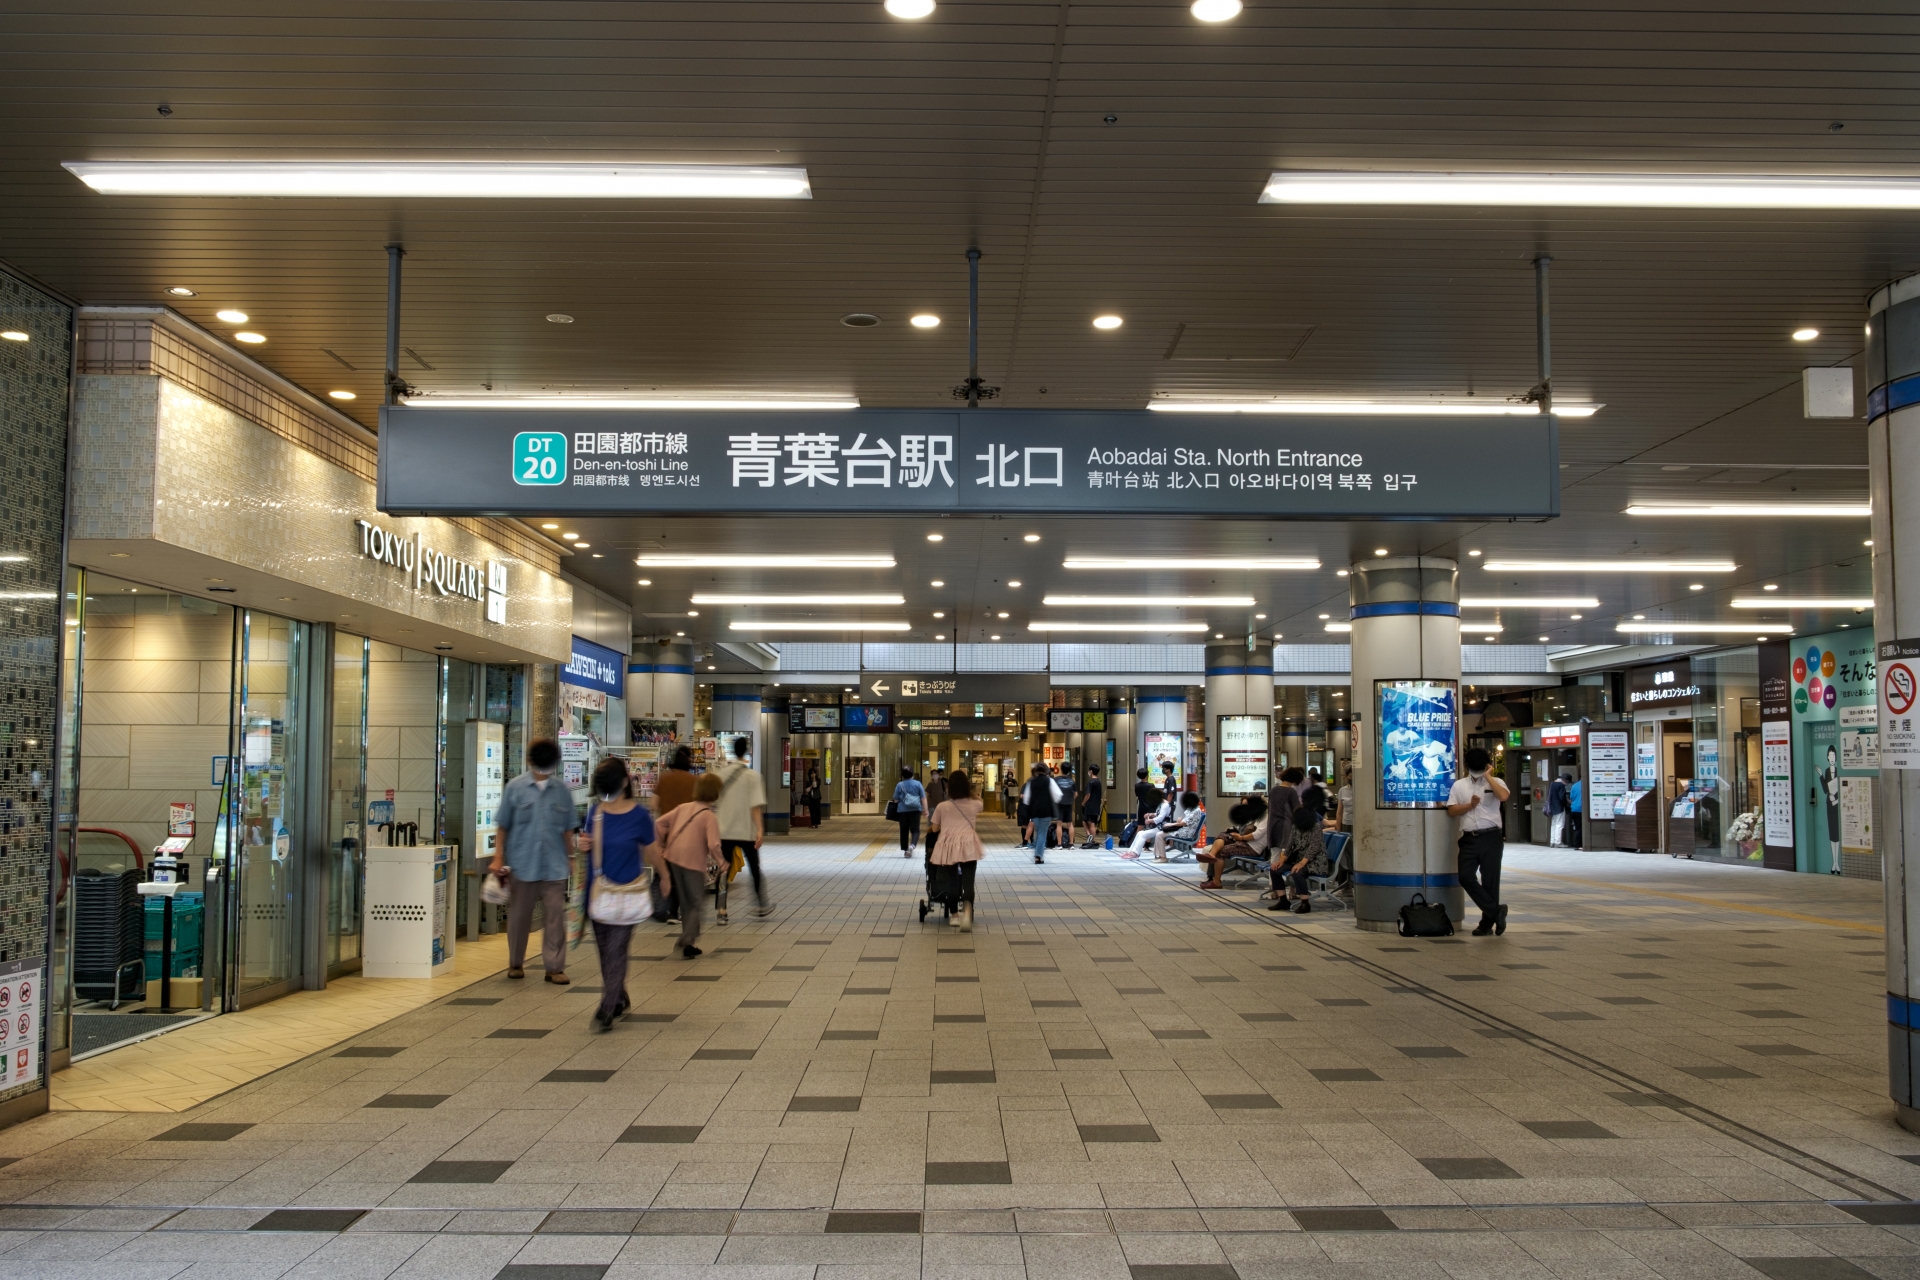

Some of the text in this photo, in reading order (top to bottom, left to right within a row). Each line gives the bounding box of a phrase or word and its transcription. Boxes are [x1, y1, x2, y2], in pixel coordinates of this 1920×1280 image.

[528, 438, 553, 453] DT
[574, 432, 688, 455] 田園都市線
[573, 458, 689, 471] Den-en-toshi Line
[726, 432, 1064, 489] 青葉台駅 北口
[1087, 447, 1363, 467] Aobadai Sta. North Entrance
[522, 456, 557, 480] 20
[573, 474, 630, 487] 田园都市线
[1087, 470, 1418, 491] 青叶台站 北入口 아오바다이역 북쪽 입구
[359, 519, 485, 602] TOKYU SQUARE
[1881, 645, 1900, 656] お願い
[603, 662, 616, 685] toks
[1839, 660, 1877, 683] そんな
[919, 680, 957, 690] きっぷうりば
[1630, 685, 1701, 703] 住まいと暮らしのコンシェルジュ
[1407, 712, 1452, 722] BLUE PRIDE
[1889, 719, 1911, 732] 禁煙
[1843, 738, 1847, 748] 1
[1866, 736, 1871, 747] 2
